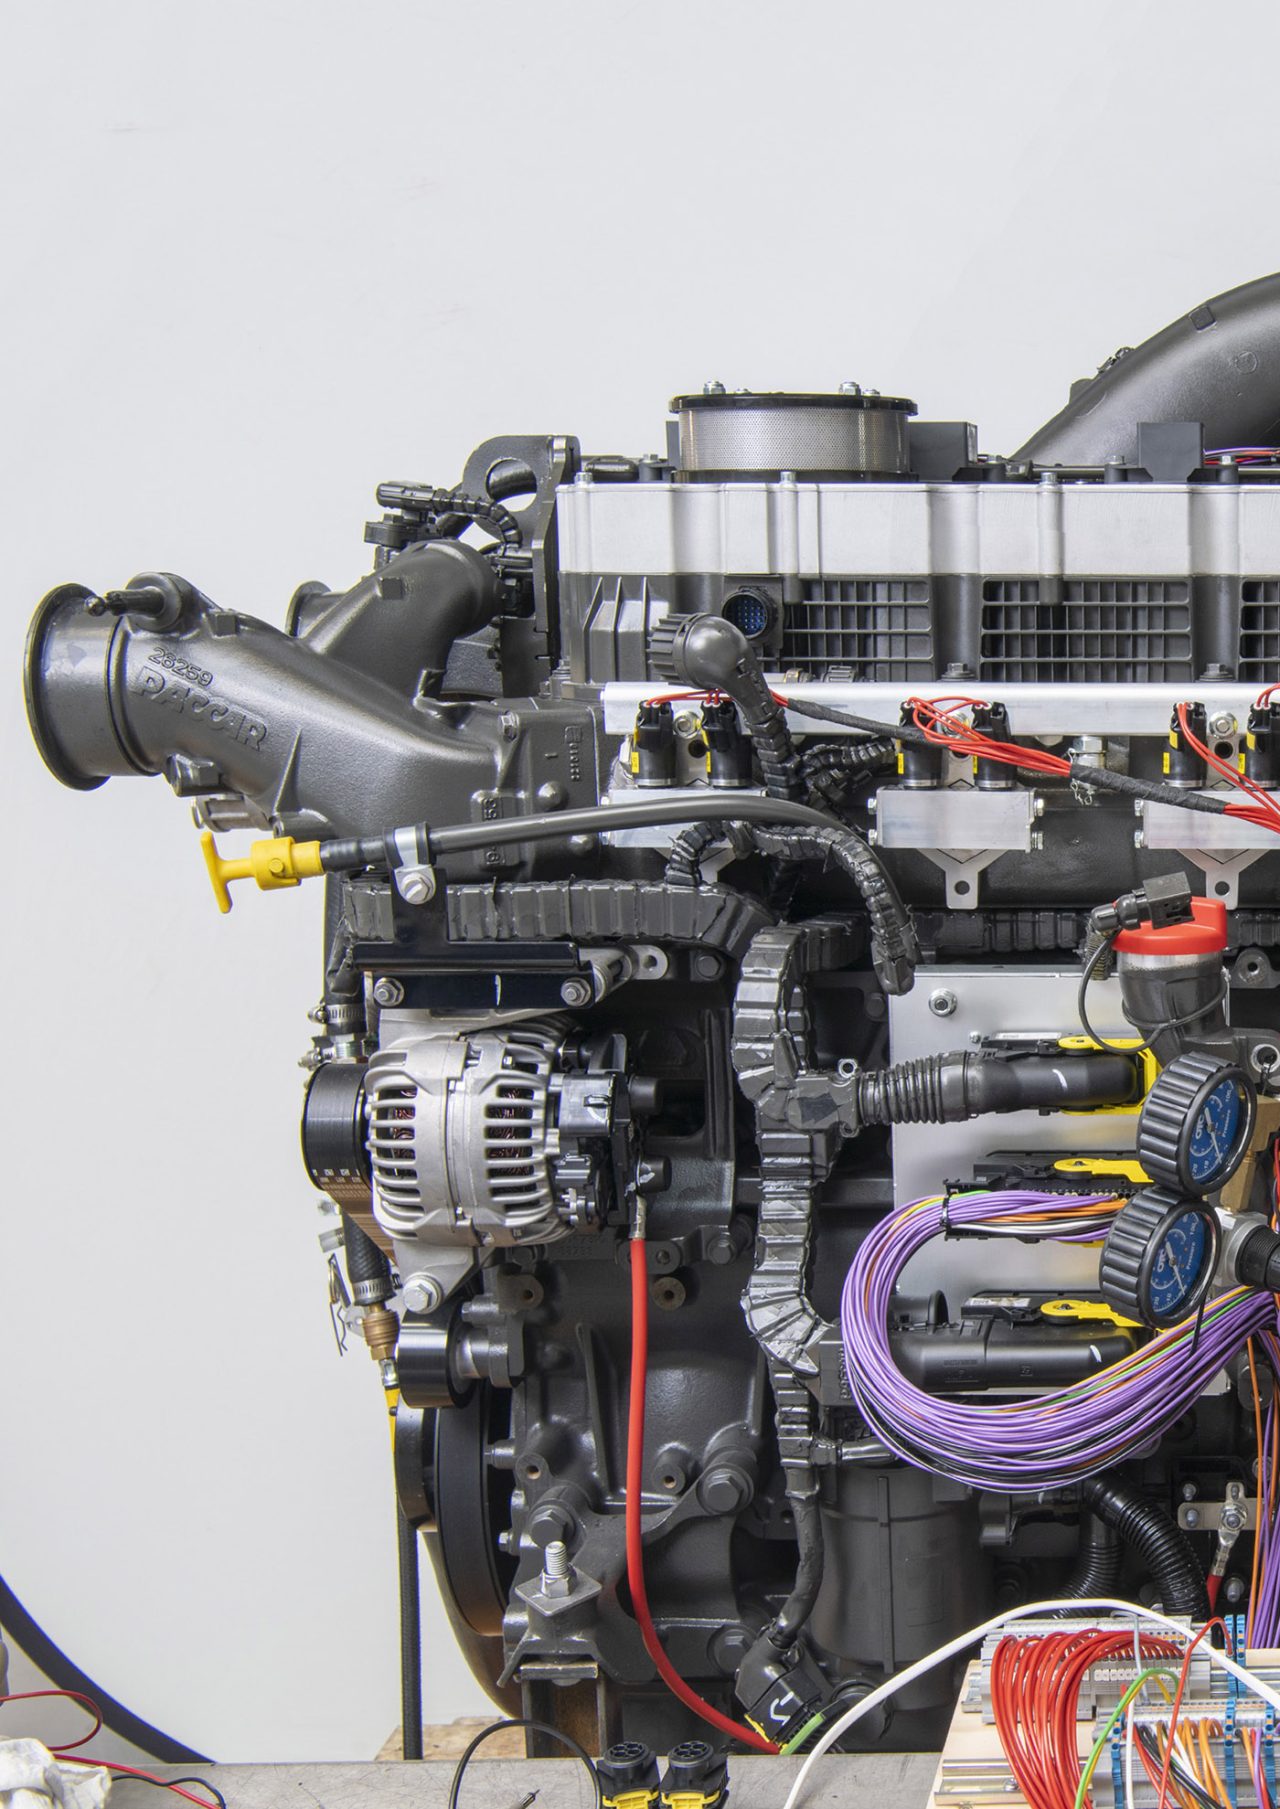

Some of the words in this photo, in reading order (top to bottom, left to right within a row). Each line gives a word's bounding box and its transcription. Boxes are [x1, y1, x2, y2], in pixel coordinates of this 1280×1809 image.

[133, 665, 268, 751] PACCAR
[1195, 1114, 1205, 1140] OTC
[1157, 1248, 1166, 1273] OTC
